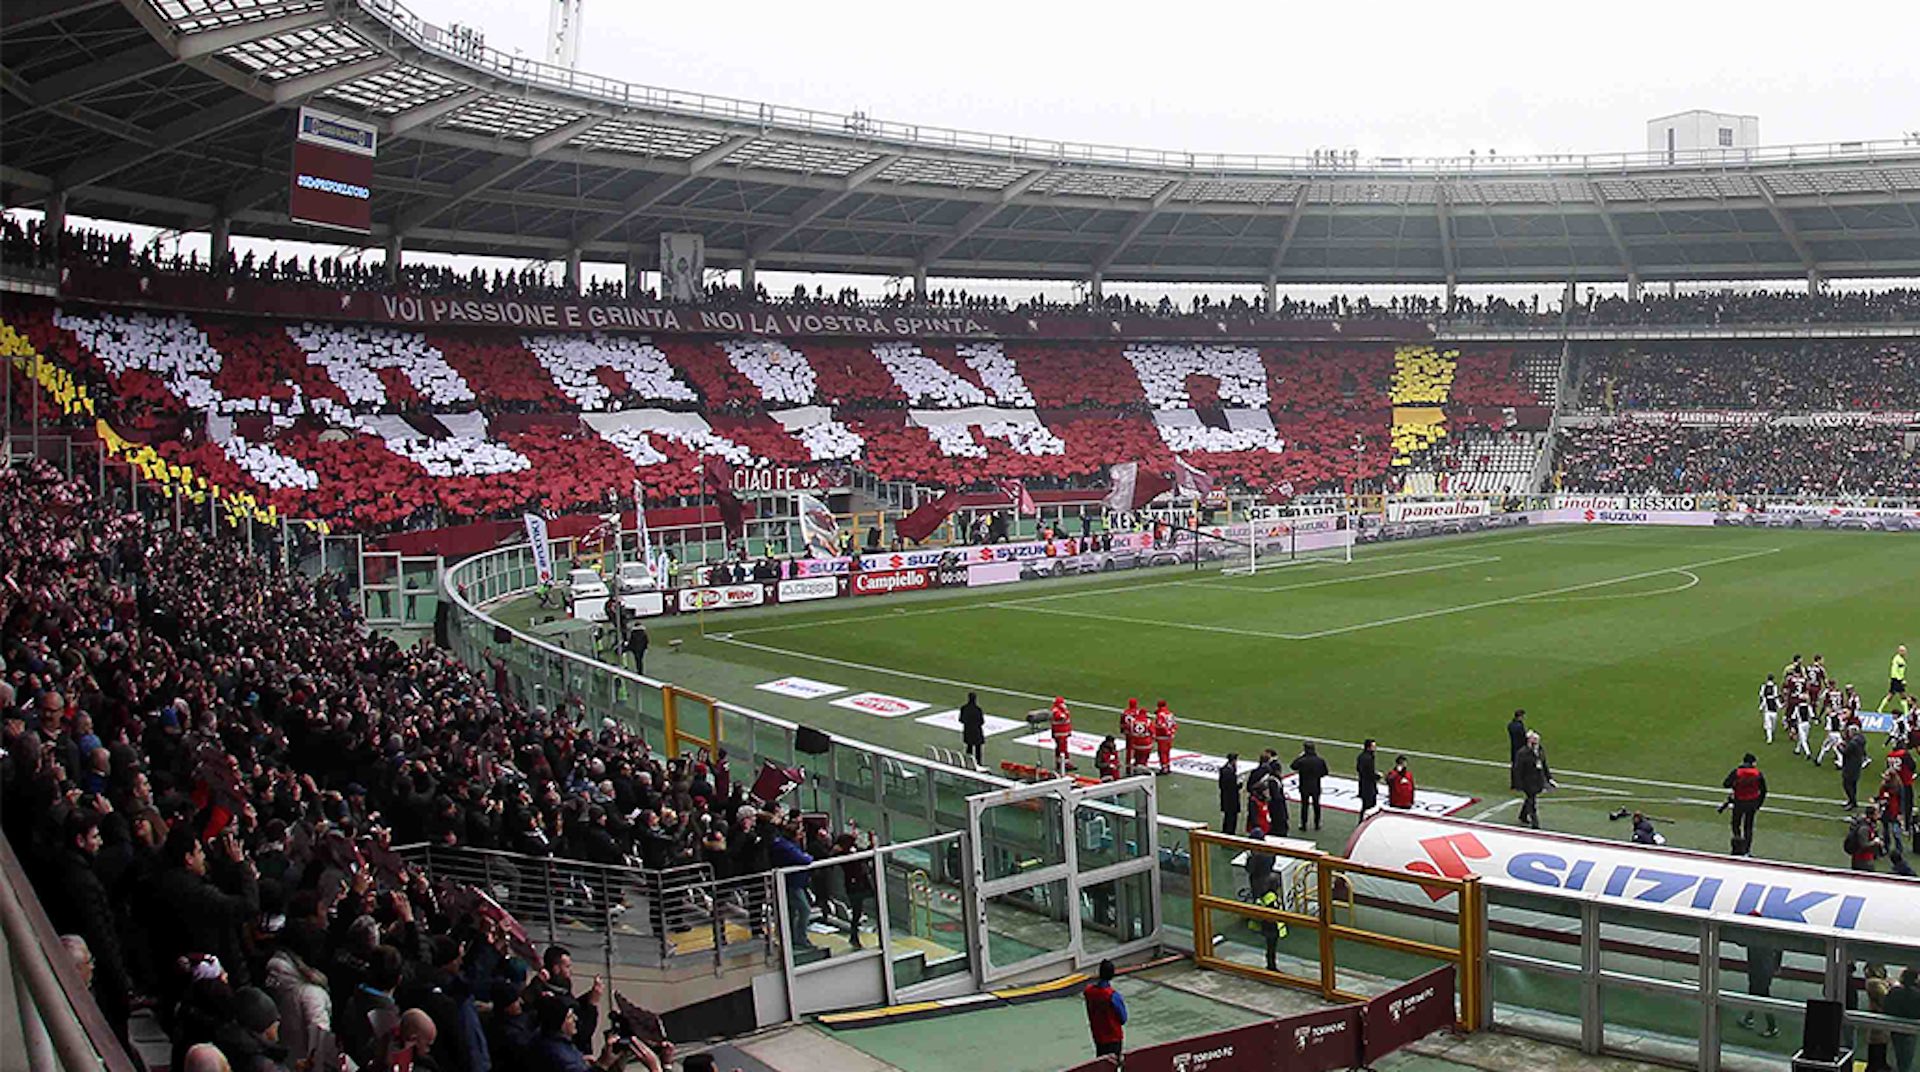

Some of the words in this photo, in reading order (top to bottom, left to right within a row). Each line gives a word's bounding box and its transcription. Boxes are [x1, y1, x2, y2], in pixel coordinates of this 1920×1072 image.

[383, 295, 423, 322] VOI
[430, 299, 559, 327] PASSIONE
[565, 306, 582, 327] E
[588, 306, 681, 330] GRINTA
[700, 312, 744, 331] NOI
[750, 313, 781, 334] LA
[786, 314, 891, 334] VOSTRA
[734, 469, 772, 491] CIAO
[1629, 497, 1695, 511] RISSKIO
[1600, 512, 1648, 522] SUZUKI
[809, 558, 878, 575] SUZKI
[907, 551, 969, 567] SUZKI
[856, 567, 924, 591] Campiello
[941, 570, 967, 584] 00:00
